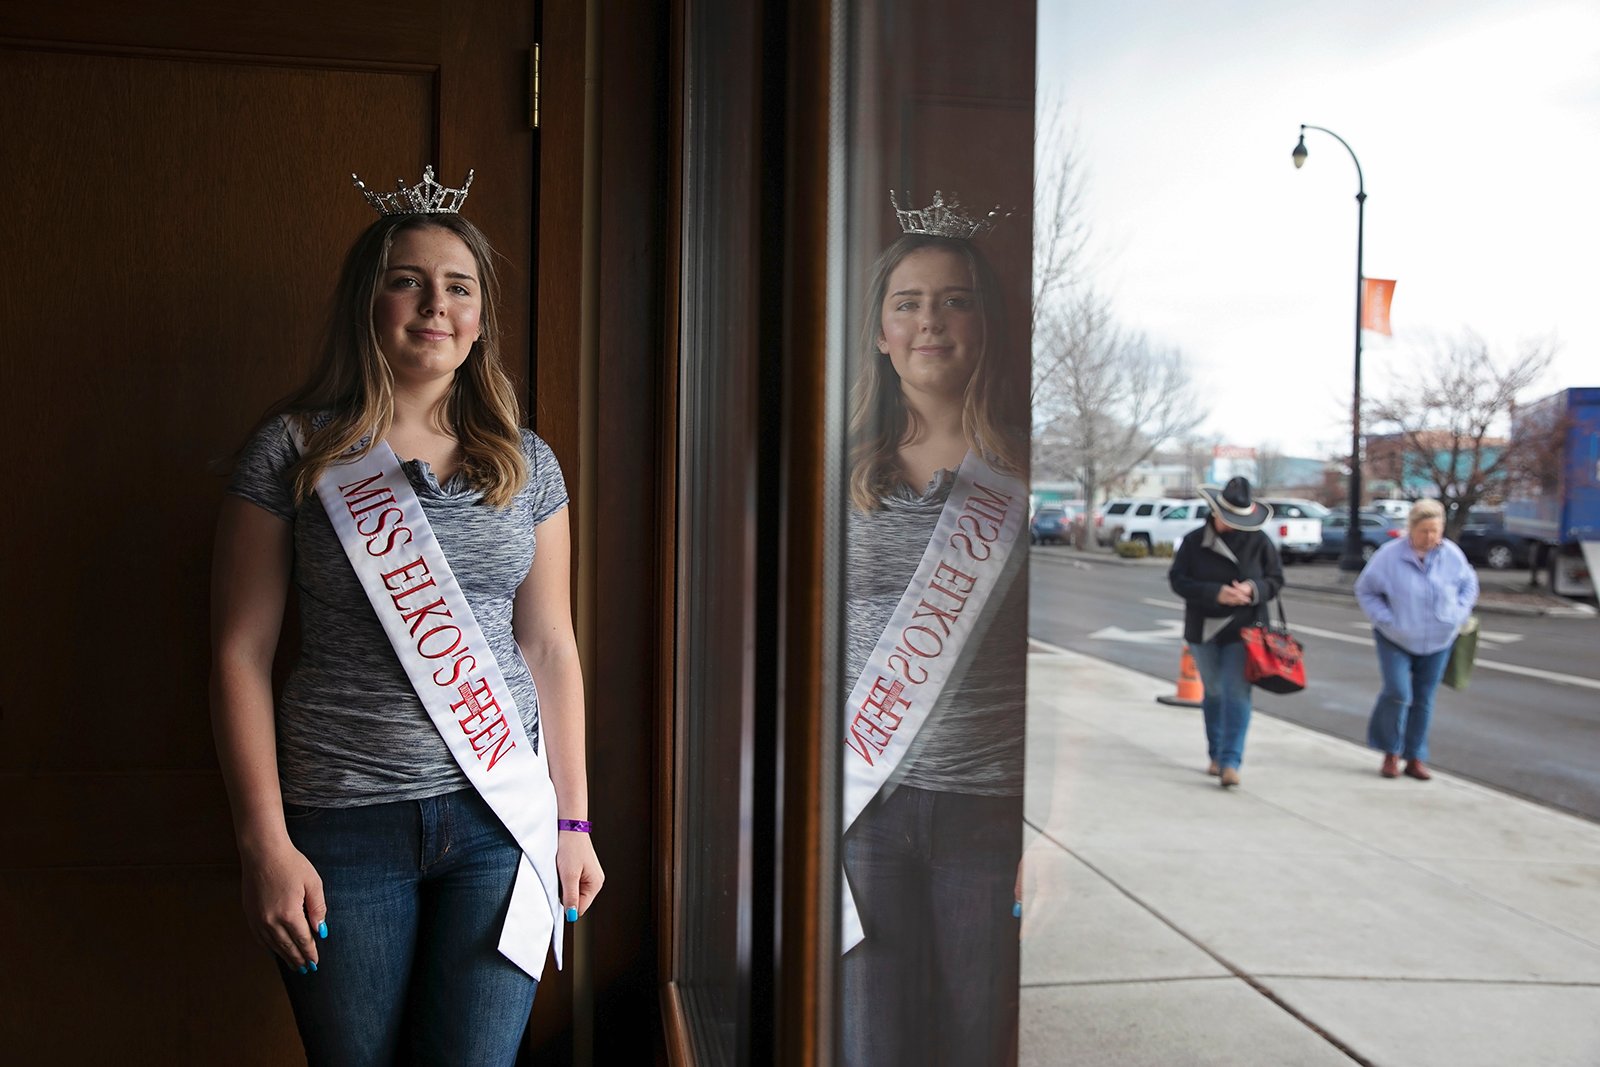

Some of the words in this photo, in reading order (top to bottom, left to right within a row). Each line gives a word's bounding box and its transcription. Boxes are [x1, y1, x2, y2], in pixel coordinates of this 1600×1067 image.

[338, 471, 412, 557] MISS
[380, 555, 476, 687] ELKO'S
[449, 677, 516, 772] TEEN
